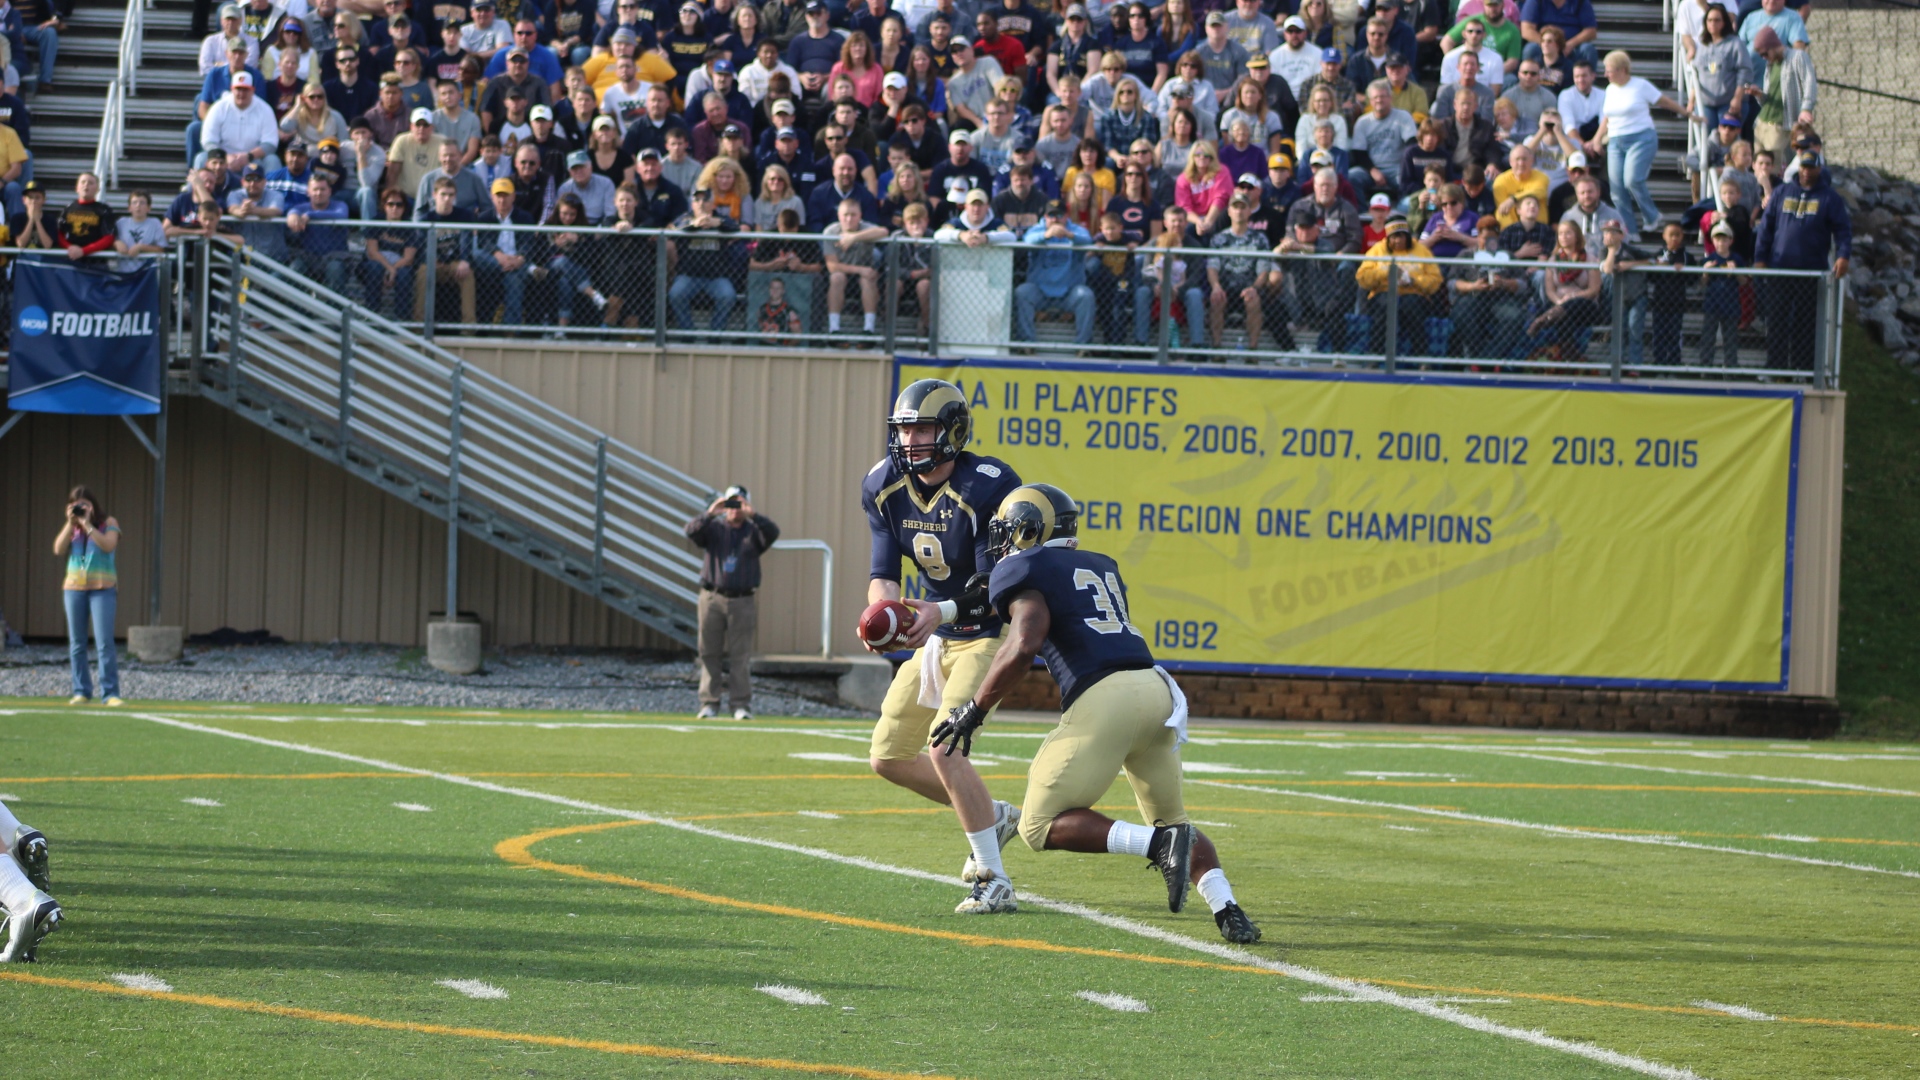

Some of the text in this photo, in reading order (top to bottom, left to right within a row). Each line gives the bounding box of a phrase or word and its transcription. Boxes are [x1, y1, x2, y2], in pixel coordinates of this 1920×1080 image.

[51, 311, 153, 338] FOOTBALL
[1004, 382, 1019, 411] II
[1035, 383, 1178, 417] PLAYOFFS
[998, 416, 1069, 450] 1999,
[1086, 420, 1167, 453] 2005,
[1183, 424, 1265, 458] 2006,
[1281, 428, 1361, 461] 2007,
[1378, 431, 1448, 464] 2010,
[1464, 434, 1528, 465] 2012
[1552, 436, 1623, 467] 2013,
[1635, 438, 1698, 468] 2015
[976, 464, 1002, 478] 8
[902, 519, 948, 532] SHEPHERD
[1139, 503, 1241, 535] REGION
[1256, 508, 1312, 538] ONE
[1327, 510, 1493, 545] CHAMPIONS
[912, 532, 951, 581] 8
[1073, 568, 1144, 639] 31
[1248, 551, 1446, 622] FOOTBALL
[1154, 620, 1218, 650] 1992
